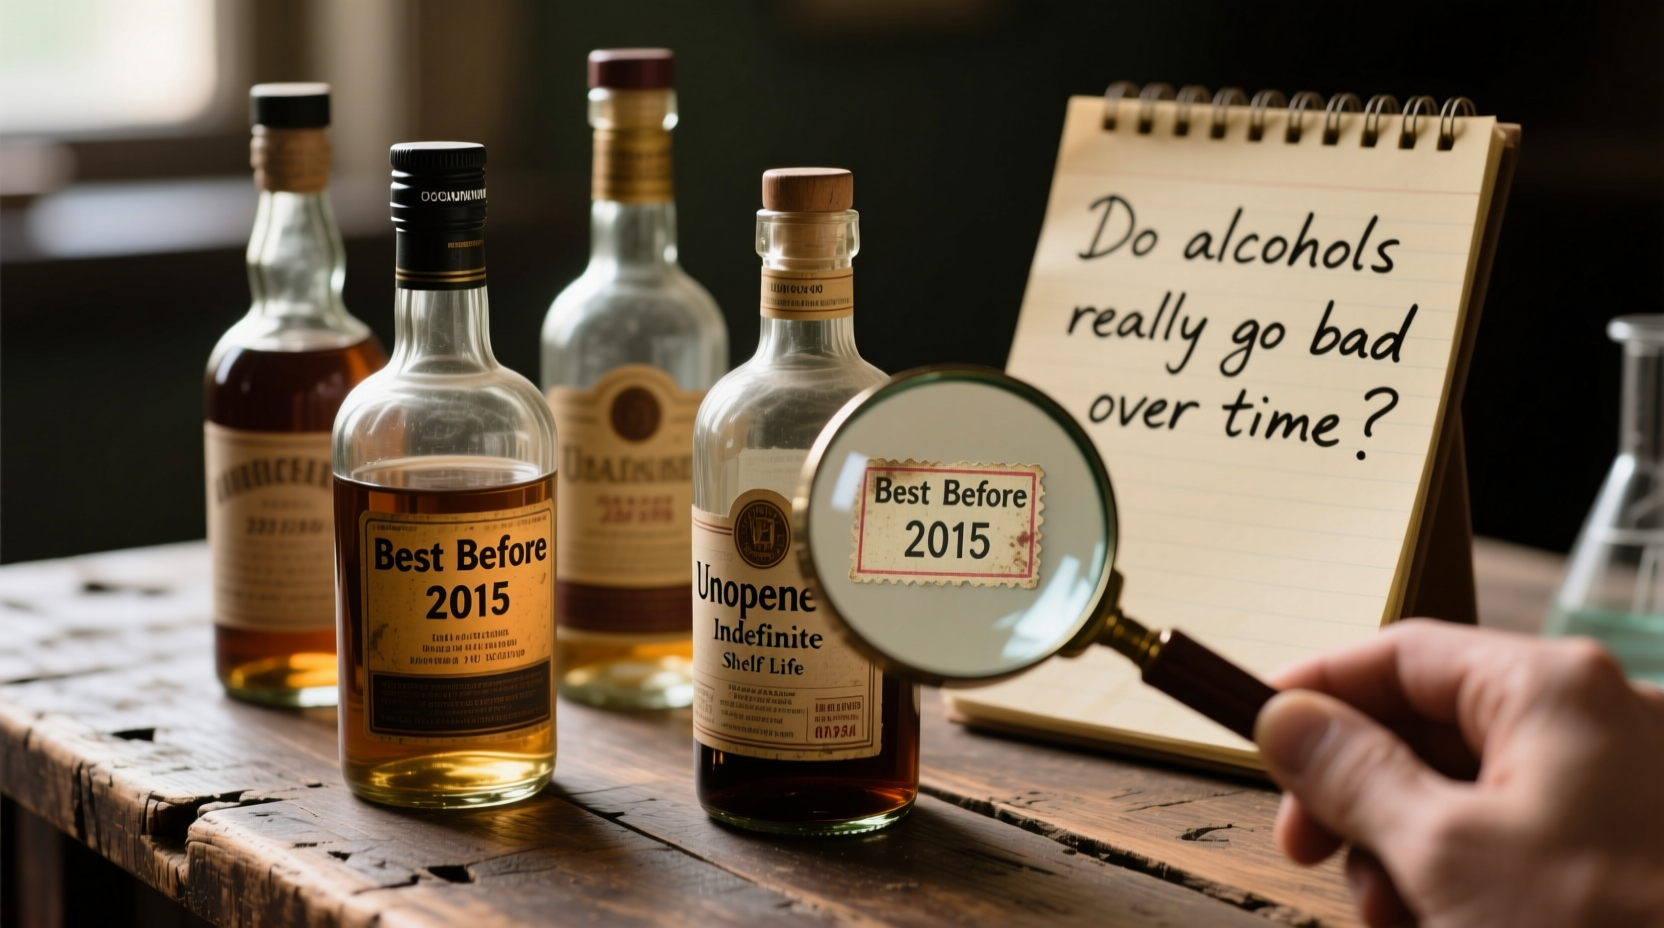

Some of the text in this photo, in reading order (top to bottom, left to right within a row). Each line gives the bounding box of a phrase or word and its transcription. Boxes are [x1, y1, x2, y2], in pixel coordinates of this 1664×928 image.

[1078, 194, 1401, 275] Do alcohols
[1066, 291, 1419, 378] really go bad
[1088, 393, 1200, 431] over
[874, 476, 1028, 509] Best Before
[374, 534, 547, 573] Best Before
[903, 519, 991, 560] 2015
[425, 580, 511, 620] 2015
[713, 617, 824, 650] Indefinite
[721, 651, 805, 676] Shelf Life
